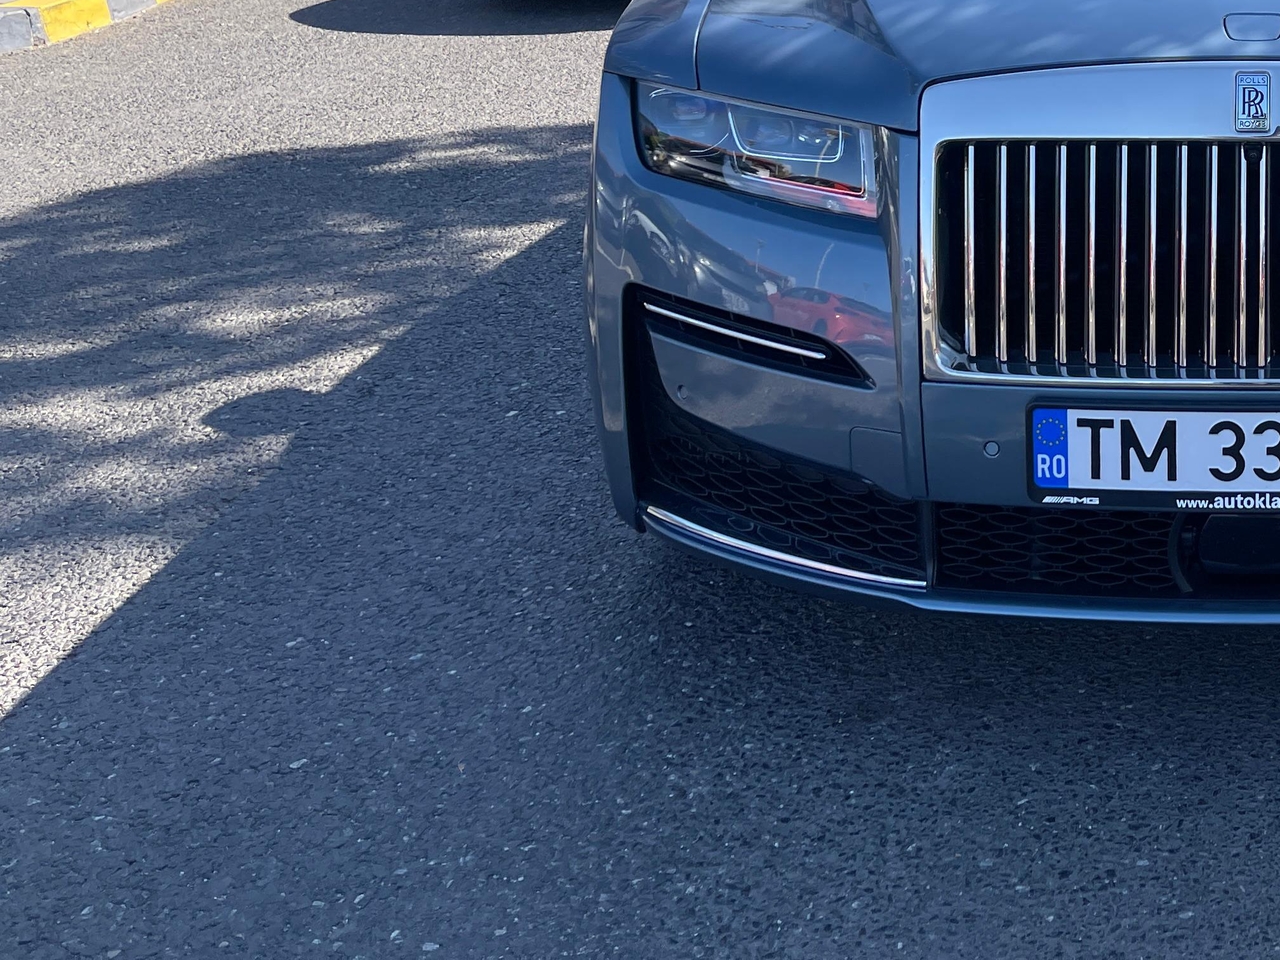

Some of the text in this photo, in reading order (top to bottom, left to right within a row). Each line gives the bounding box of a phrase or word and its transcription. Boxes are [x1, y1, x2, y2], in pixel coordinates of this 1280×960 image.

[1076, 418, 1177, 481] TM
[1037, 453, 1065, 478] RO
[1061, 496, 1099, 504] AMG
